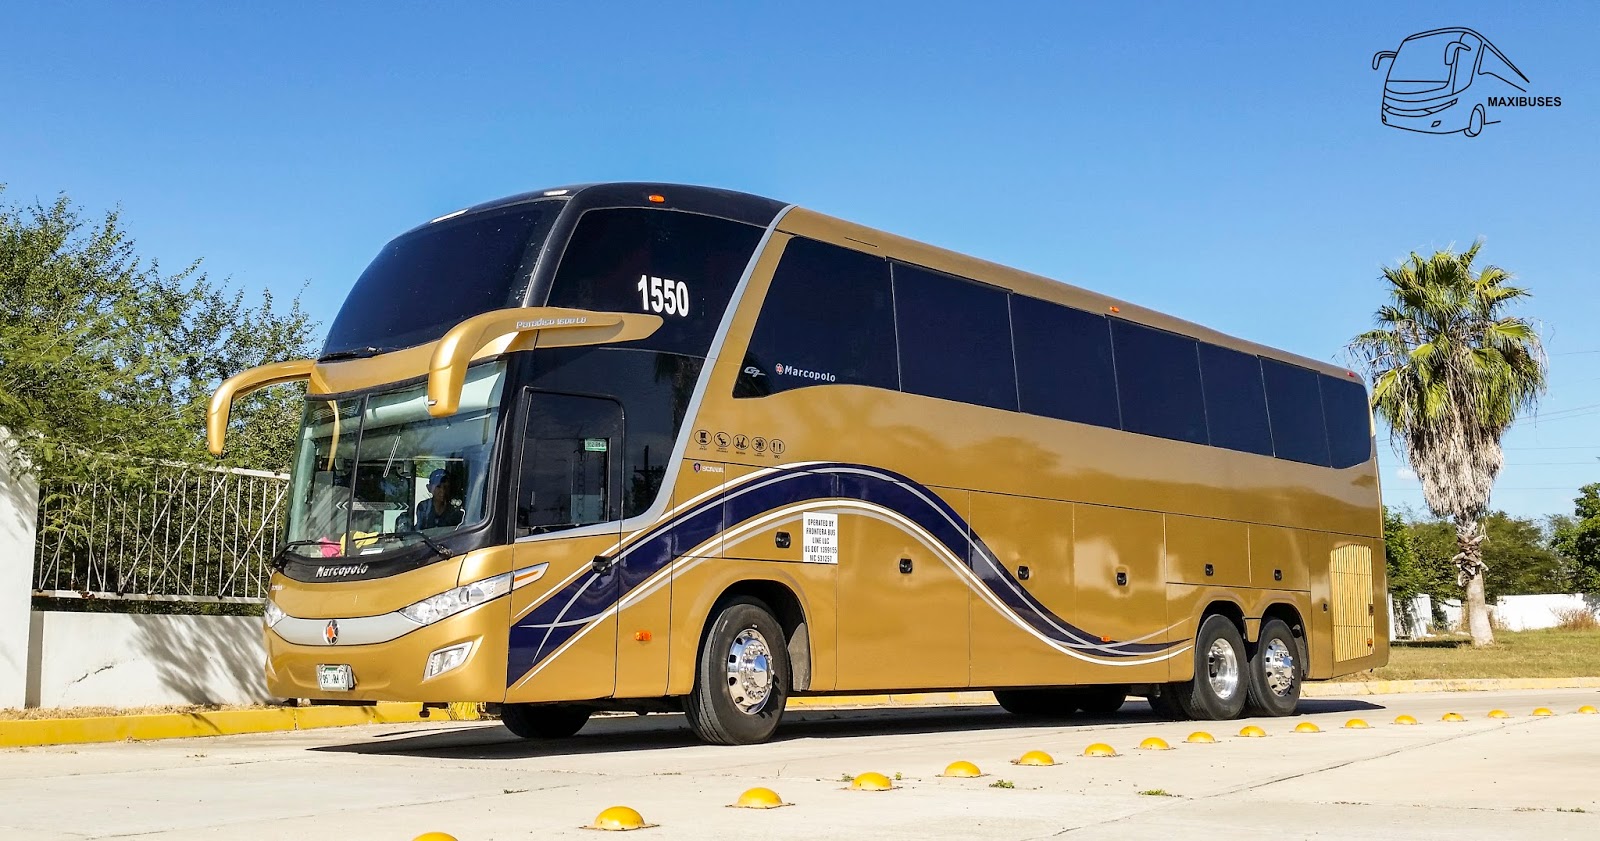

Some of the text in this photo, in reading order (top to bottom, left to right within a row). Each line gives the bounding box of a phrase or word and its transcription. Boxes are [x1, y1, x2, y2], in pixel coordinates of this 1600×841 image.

[637, 274, 690, 317] 1550
[516, 318, 555, 329] Paradiso
[784, 365, 836, 382] Marcopolo
[808, 518, 828, 526] OPERATED
[316, 563, 369, 578] Marcopolo
